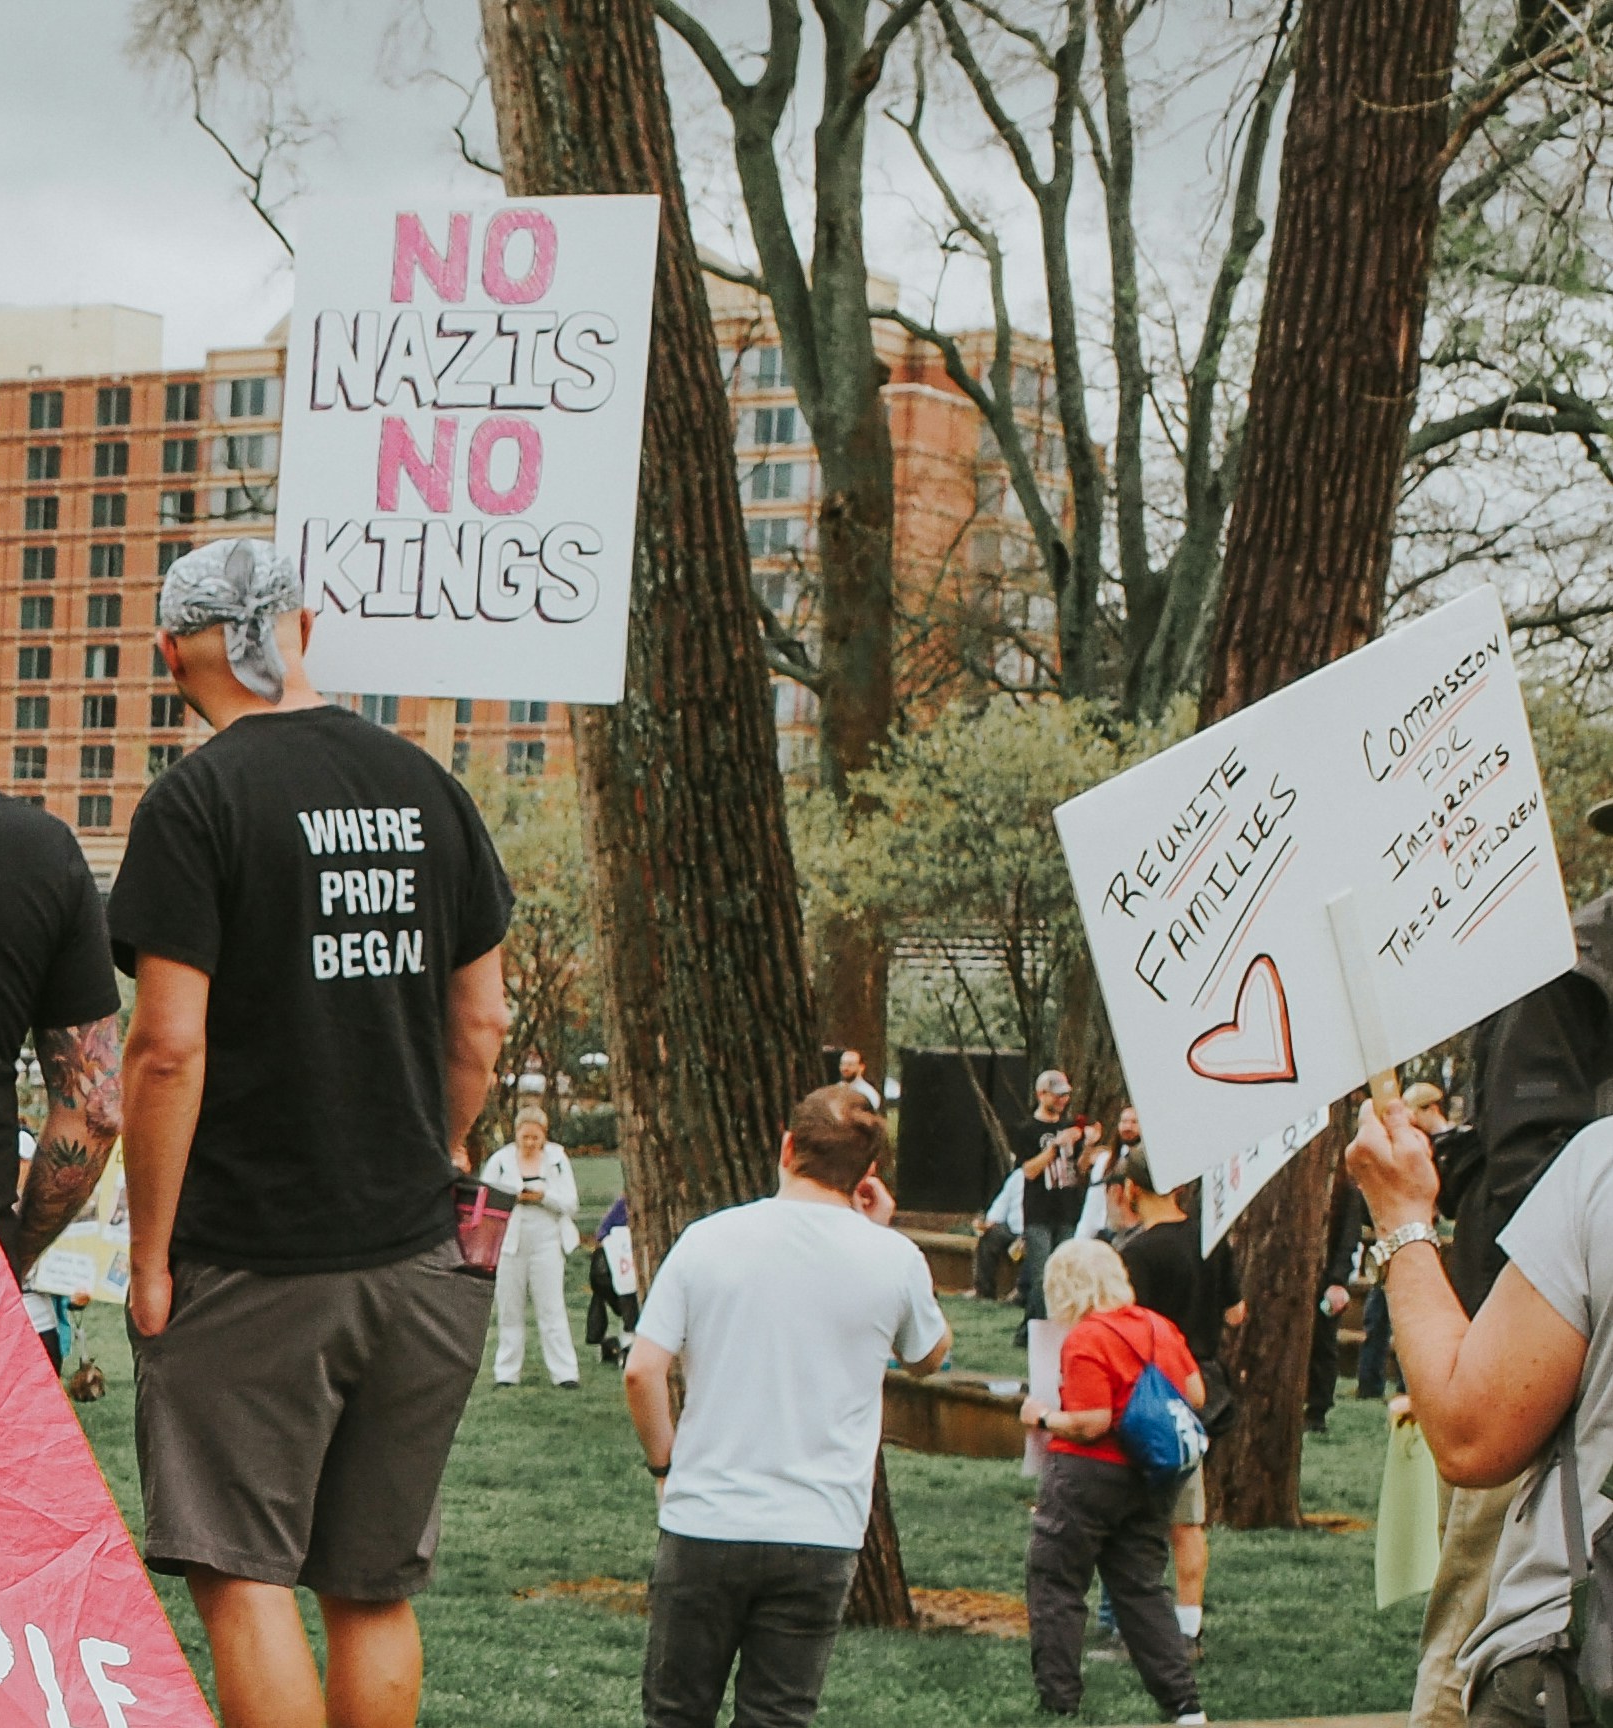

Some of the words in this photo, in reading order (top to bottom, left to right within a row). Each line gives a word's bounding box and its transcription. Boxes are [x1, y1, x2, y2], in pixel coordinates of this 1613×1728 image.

[390, 206, 558, 303] NO
[310, 310, 619, 412] NAZIS
[377, 415, 543, 515] NO
[300, 519, 603, 622] KINGS
[1363, 633, 1501, 782] COMPASSION
[1418, 725, 1472, 783] FOR
[298, 808, 425, 854] WHERE
[1102, 746, 1247, 918] REUNITE
[1382, 744, 1510, 882] IMIGRANTS
[1442, 816, 1477, 858] AND
[1135, 773, 1296, 1002] FAMILIES
[1378, 886, 1451, 966] THEIR
[1455, 792, 1538, 889] CHILDREN
